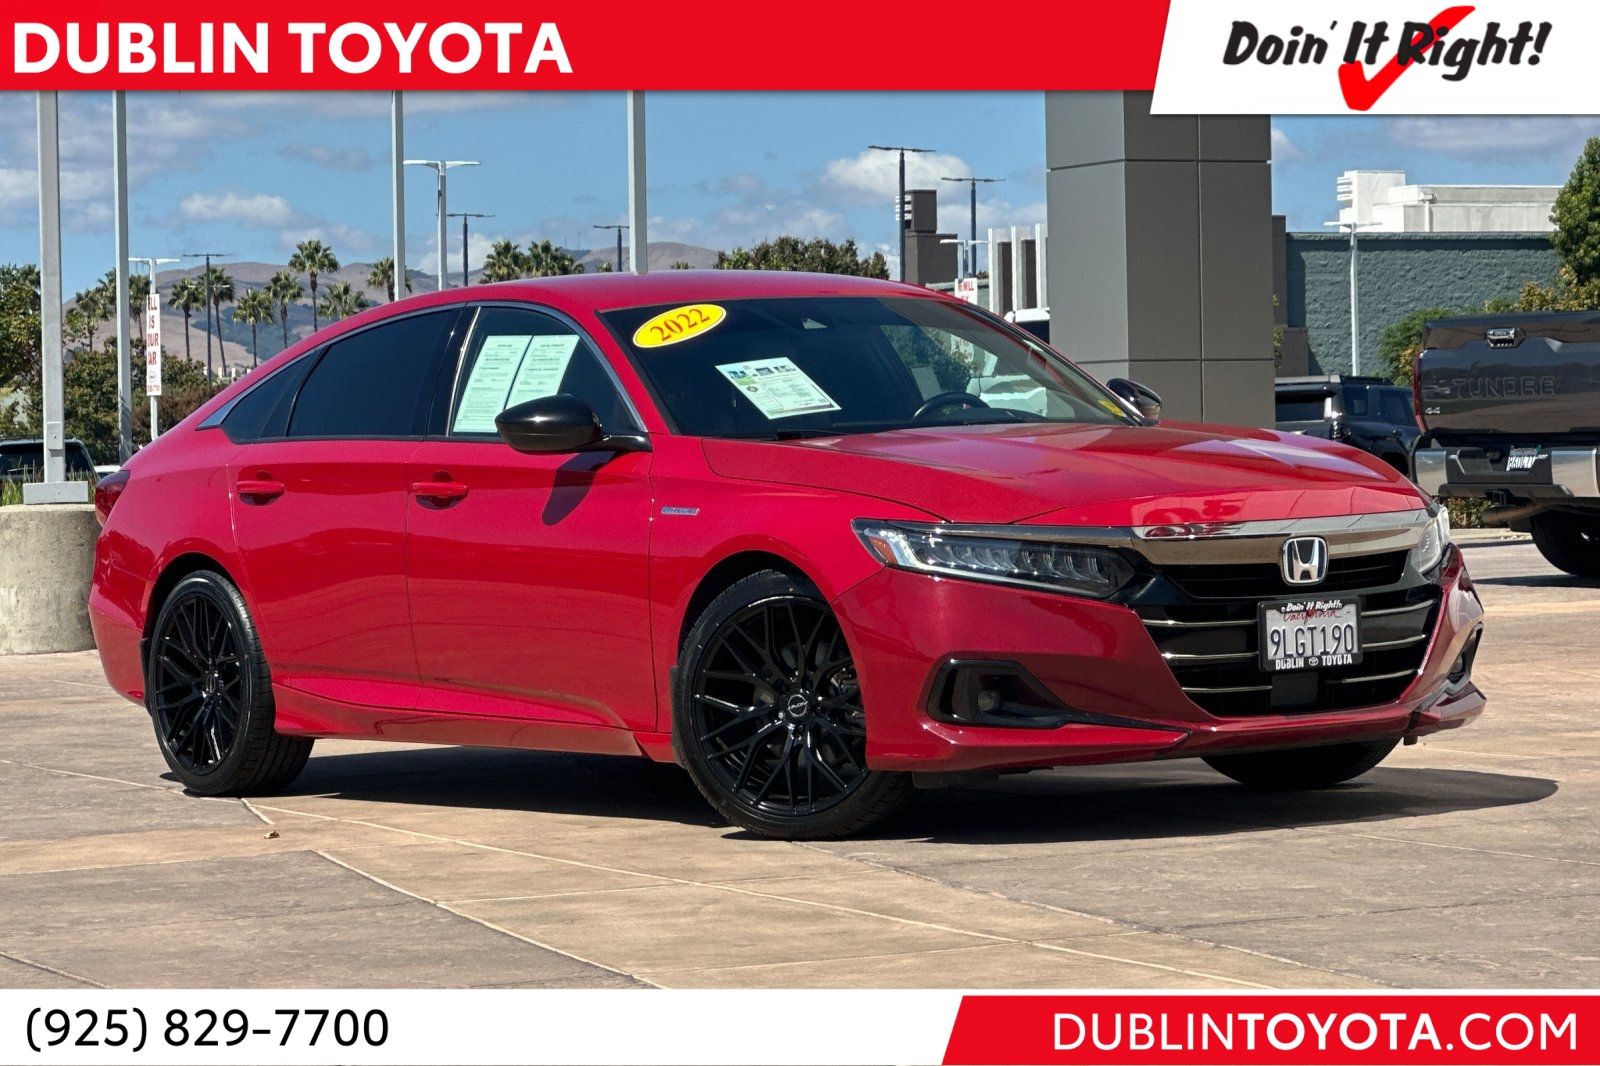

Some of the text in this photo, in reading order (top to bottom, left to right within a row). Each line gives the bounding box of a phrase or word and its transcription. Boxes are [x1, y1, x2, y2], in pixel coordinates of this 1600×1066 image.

[650, 308, 710, 341] 2022
[1453, 376, 1556, 399] TUNDRA
[1270, 624, 1354, 657] 9LGT190
[1275, 654, 1353, 670] DUBLIN TOYOTA
